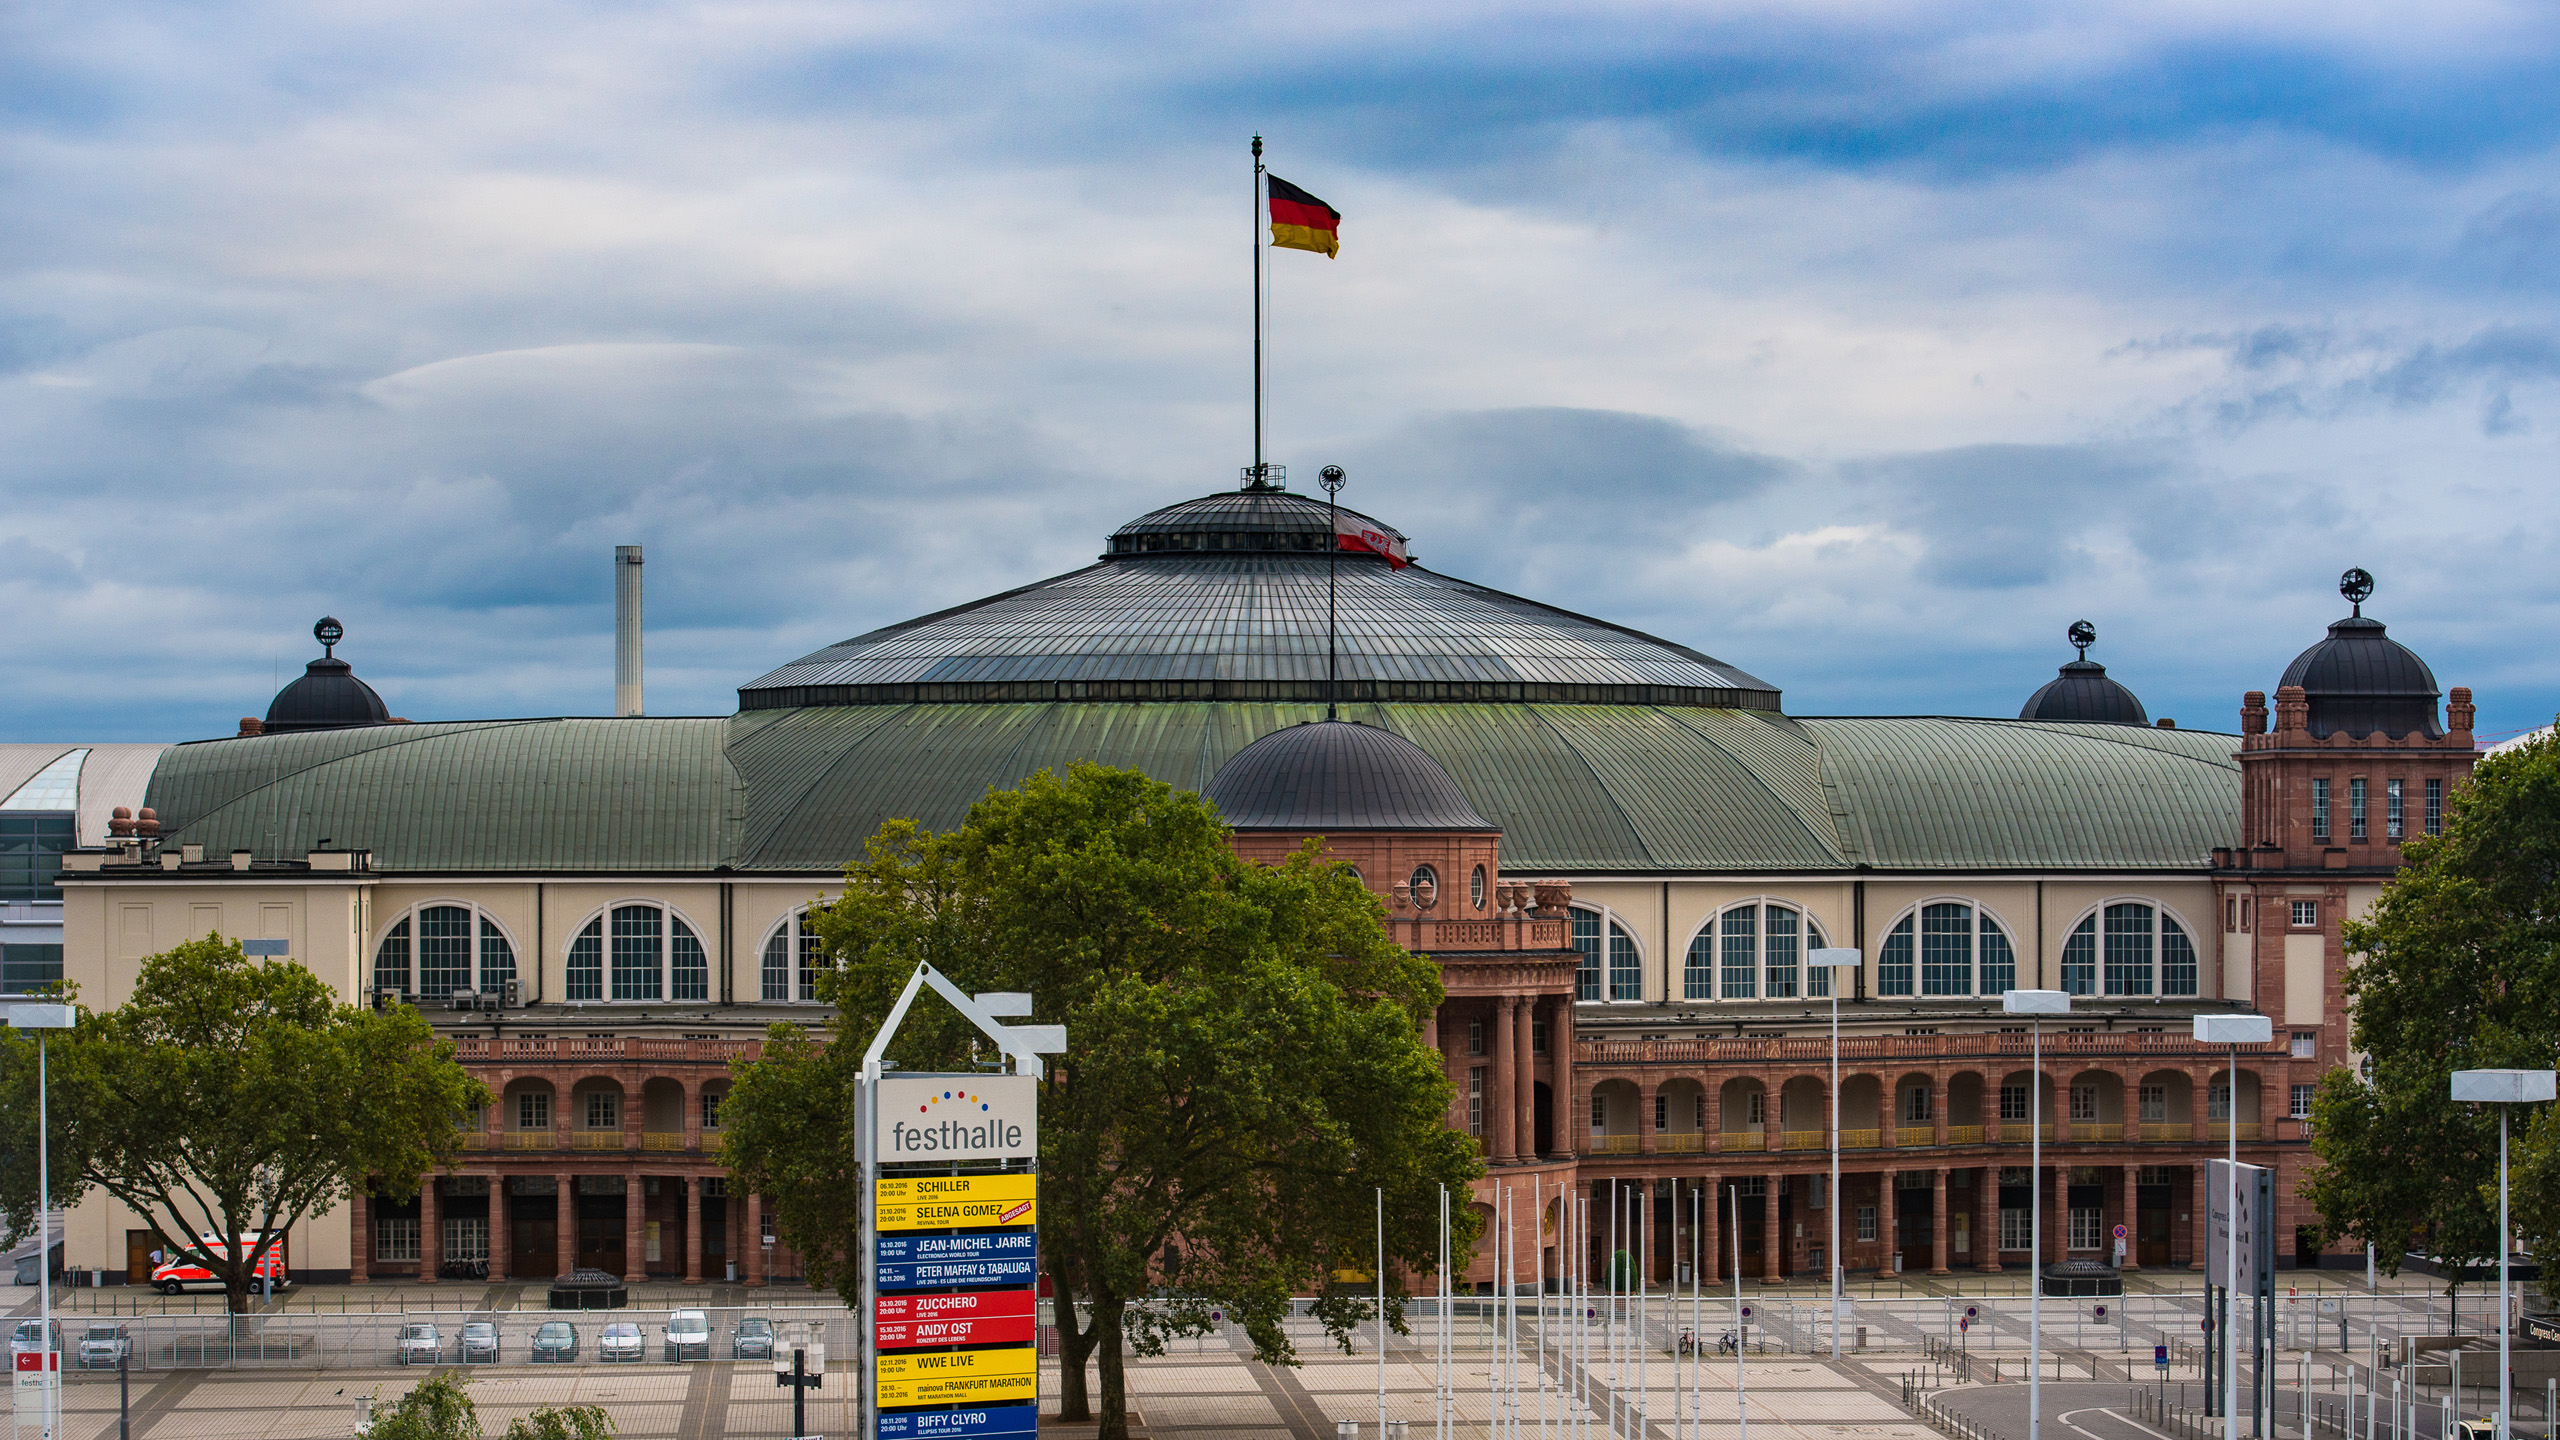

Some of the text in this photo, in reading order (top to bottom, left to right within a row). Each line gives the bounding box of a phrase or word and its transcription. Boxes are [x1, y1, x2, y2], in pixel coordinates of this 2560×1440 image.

[893, 1119, 1022, 1151] festhalle
[916, 1180, 970, 1192] SCHILLER
[916, 1204, 1002, 1218] SELENA GOMEZ
[1000, 1202, 1030, 1222] ABGESAGT
[916, 1236, 1032, 1252] JEAN-MICHEL JARRE
[916, 1262, 1031, 1278] PETER MAFFAY & TABALUGA
[916, 1296, 977, 1310] ZUCCHERO
[916, 1322, 973, 1336] ANDY OST
[2530, 1323, 2550, 1340] Congress
[917, 1355, 974, 1368] WWE LIVE
[918, 1377, 1032, 1392] mainova FRANKFURT MARATHON
[918, 1412, 986, 1428] BIFFY CLYRO
